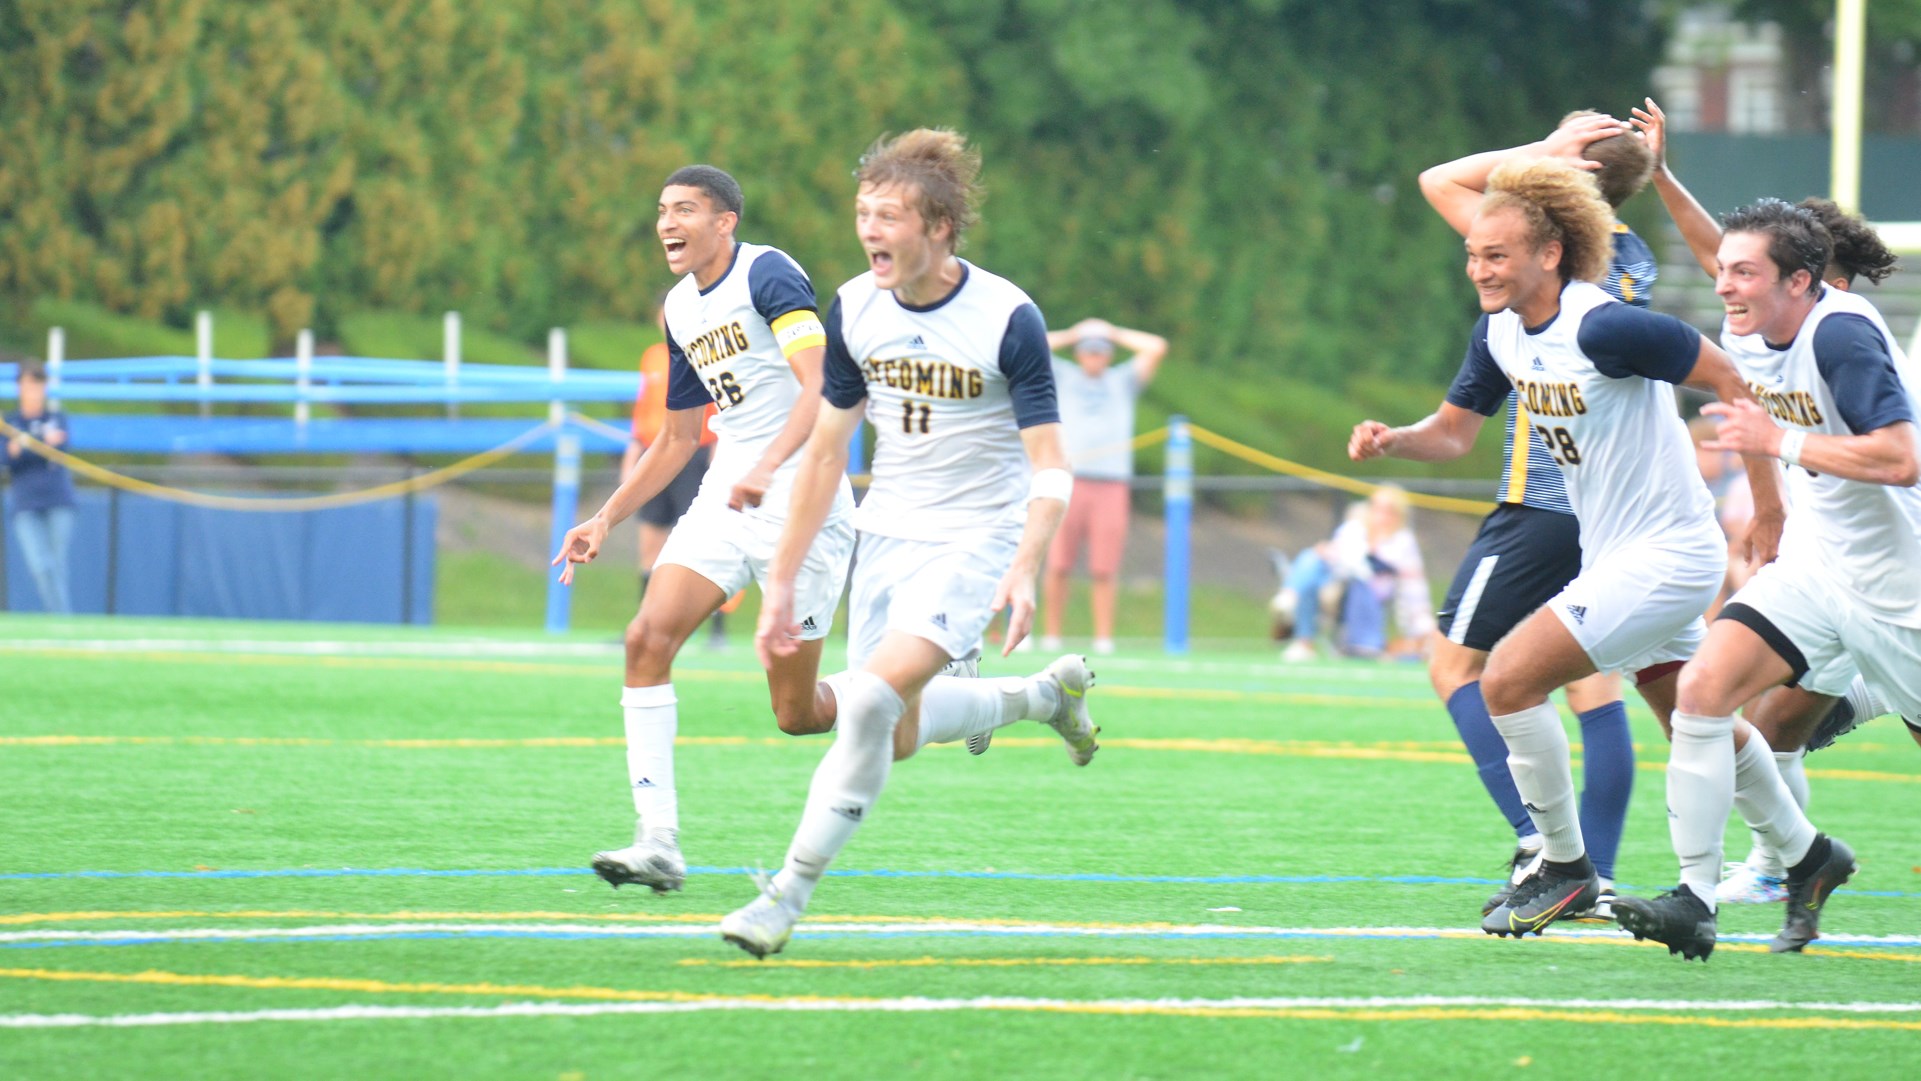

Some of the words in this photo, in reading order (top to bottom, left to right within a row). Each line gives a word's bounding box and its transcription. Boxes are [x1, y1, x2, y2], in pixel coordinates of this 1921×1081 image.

[708, 371, 746, 412] 26
[862, 356, 983, 399] YCOMING
[902, 399, 931, 434] 11
[1535, 424, 1582, 466] 28
